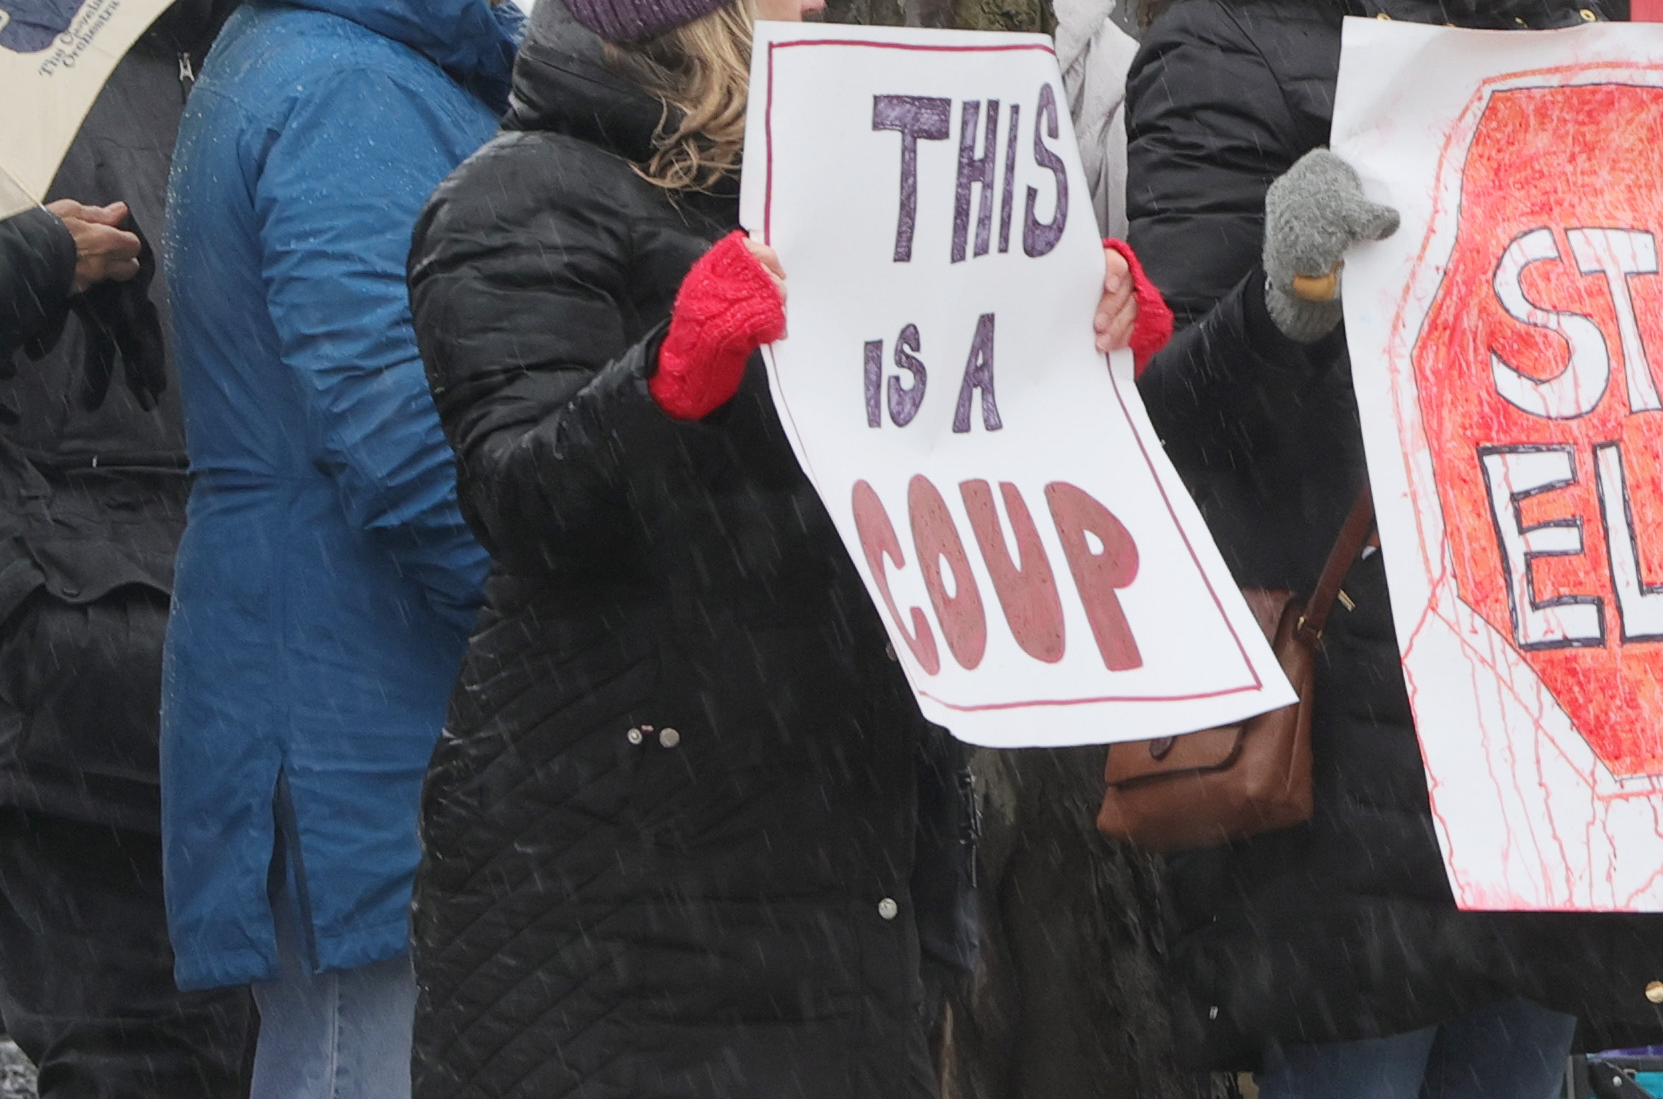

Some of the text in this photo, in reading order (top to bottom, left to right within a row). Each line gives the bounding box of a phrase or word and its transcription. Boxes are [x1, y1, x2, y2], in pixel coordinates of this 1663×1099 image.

[38, 48, 66, 76] The
[872, 83, 1069, 263] THIS
[864, 313, 1003, 433] IS A
[852, 474, 1143, 675] COUP
